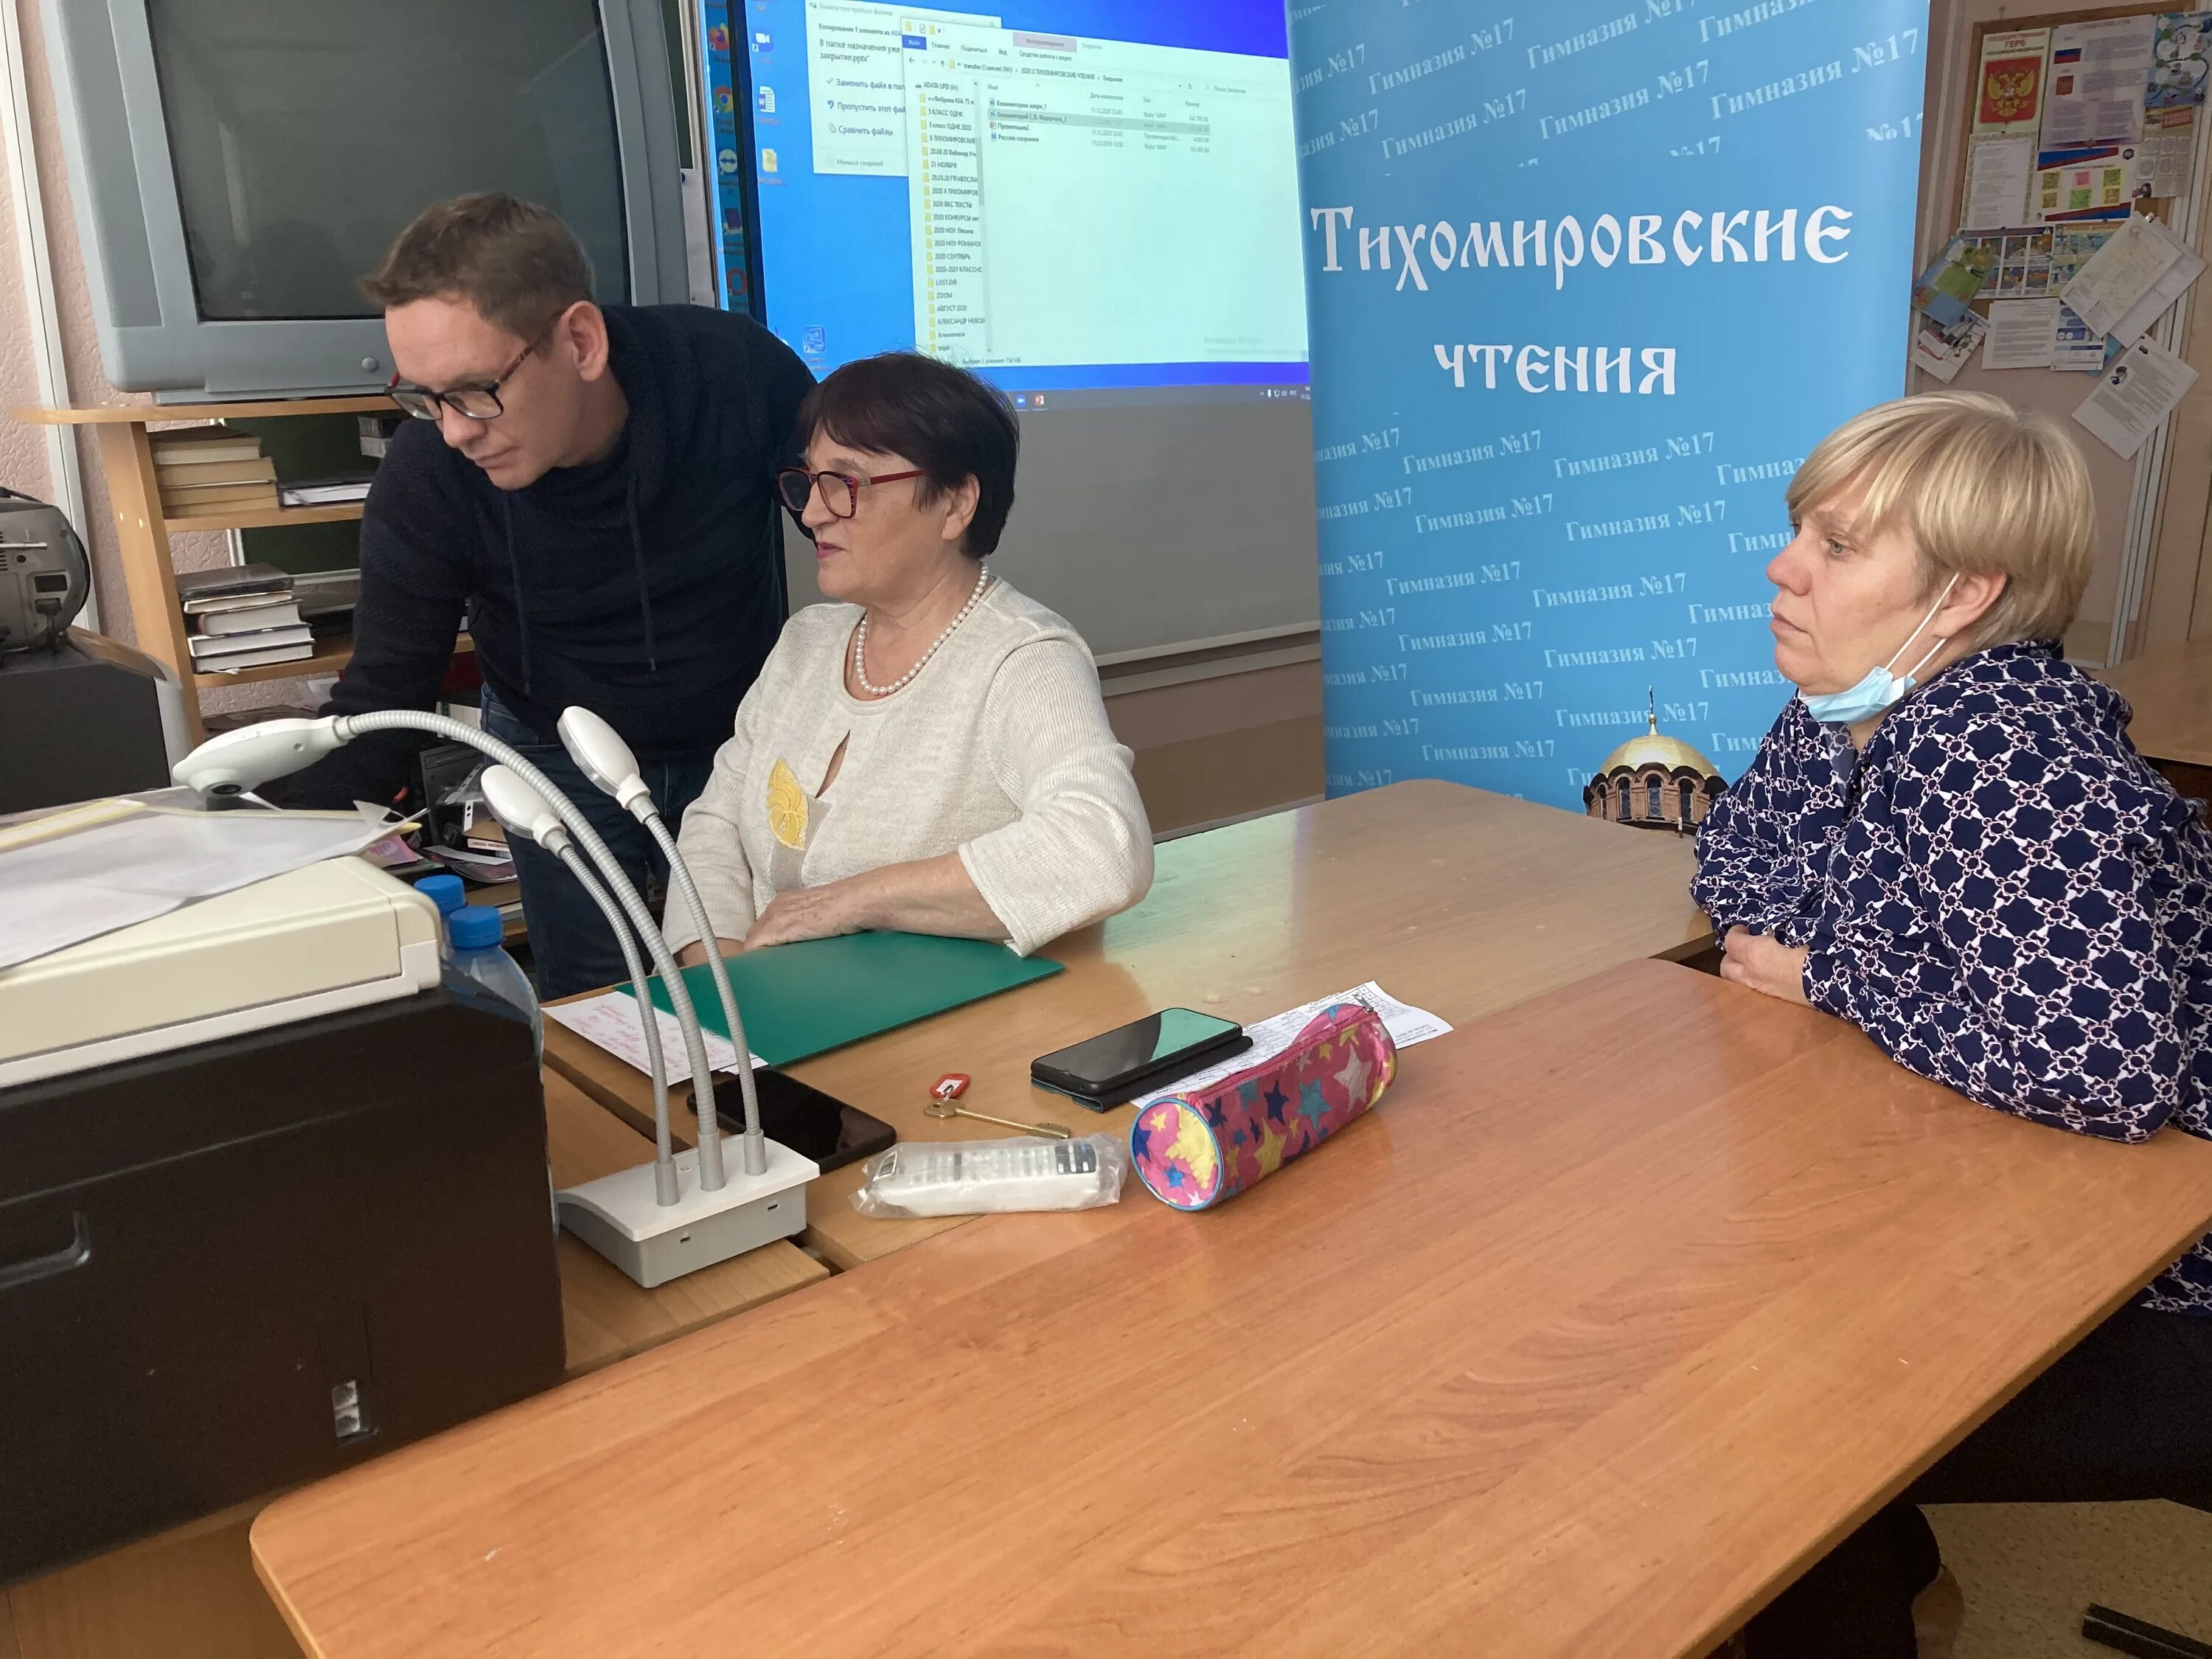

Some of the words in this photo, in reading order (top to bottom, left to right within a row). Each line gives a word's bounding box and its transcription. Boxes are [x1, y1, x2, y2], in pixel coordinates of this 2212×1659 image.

[819, 38, 824, 46] В
[825, 40, 846, 49] папке
[847, 42, 886, 52] назначения
[887, 45, 900, 54] уже
[1526, 13, 1638, 69] Гимназия
[1645, 0, 1694, 24] №1
[1328, 44, 1364, 77] №17
[1368, 45, 1465, 94] Гимназия
[1470, 18, 1513, 55] №17
[836, 78, 869, 88] Заменить
[870, 80, 887, 90] файл
[1711, 60, 1842, 119] Гимназия
[1851, 27, 1918, 73] №17
[837, 102, 877, 113] Пропустить
[1540, 88, 1649, 139] Гимназия
[1658, 59, 1708, 99] №17
[838, 125, 871, 136] Сравнить
[872, 127, 894, 137] файлы
[1340, 108, 1377, 141] №17
[1382, 114, 1477, 159] Гимназия
[1483, 88, 1525, 124] №17
[1310, 205, 1853, 291] Тихомировские
[1433, 343, 1676, 395] чтения
[1361, 428, 1399, 453] №17
[1403, 445, 1495, 474] Гимназия
[1500, 430, 1540, 456] №17
[1554, 448, 1658, 478] Гимназия
[1666, 431, 1714, 459] №17
[1374, 487, 1411, 511] №17
[1415, 507, 1506, 532] Гимназия
[1511, 493, 1552, 518] №17
[1566, 514, 1670, 540] Гимназия
[1678, 500, 1725, 526] №17
[1348, 552, 1382, 573] №17
[1386, 572, 1475, 596] Гимназия
[1481, 561, 1520, 583] №17
[1533, 585, 1633, 608] Гимназия
[1640, 573, 1685, 596] №17
[1360, 608, 1394, 627] №17
[1399, 631, 1486, 651] Гимназия
[1492, 622, 1531, 642] №17
[1545, 647, 1645, 667] Гимназия
[1651, 638, 1697, 659] №17
[1371, 663, 1406, 682] №17
[1411, 689, 1498, 706] Гимназия
[1504, 681, 1543, 700] №17
[1663, 701, 1708, 722] №17
[1382, 718, 1418, 736] №17
[1422, 745, 1509, 760] Гимназия
[1515, 740, 1554, 758] №17
[1358, 770, 1395, 789] №17
